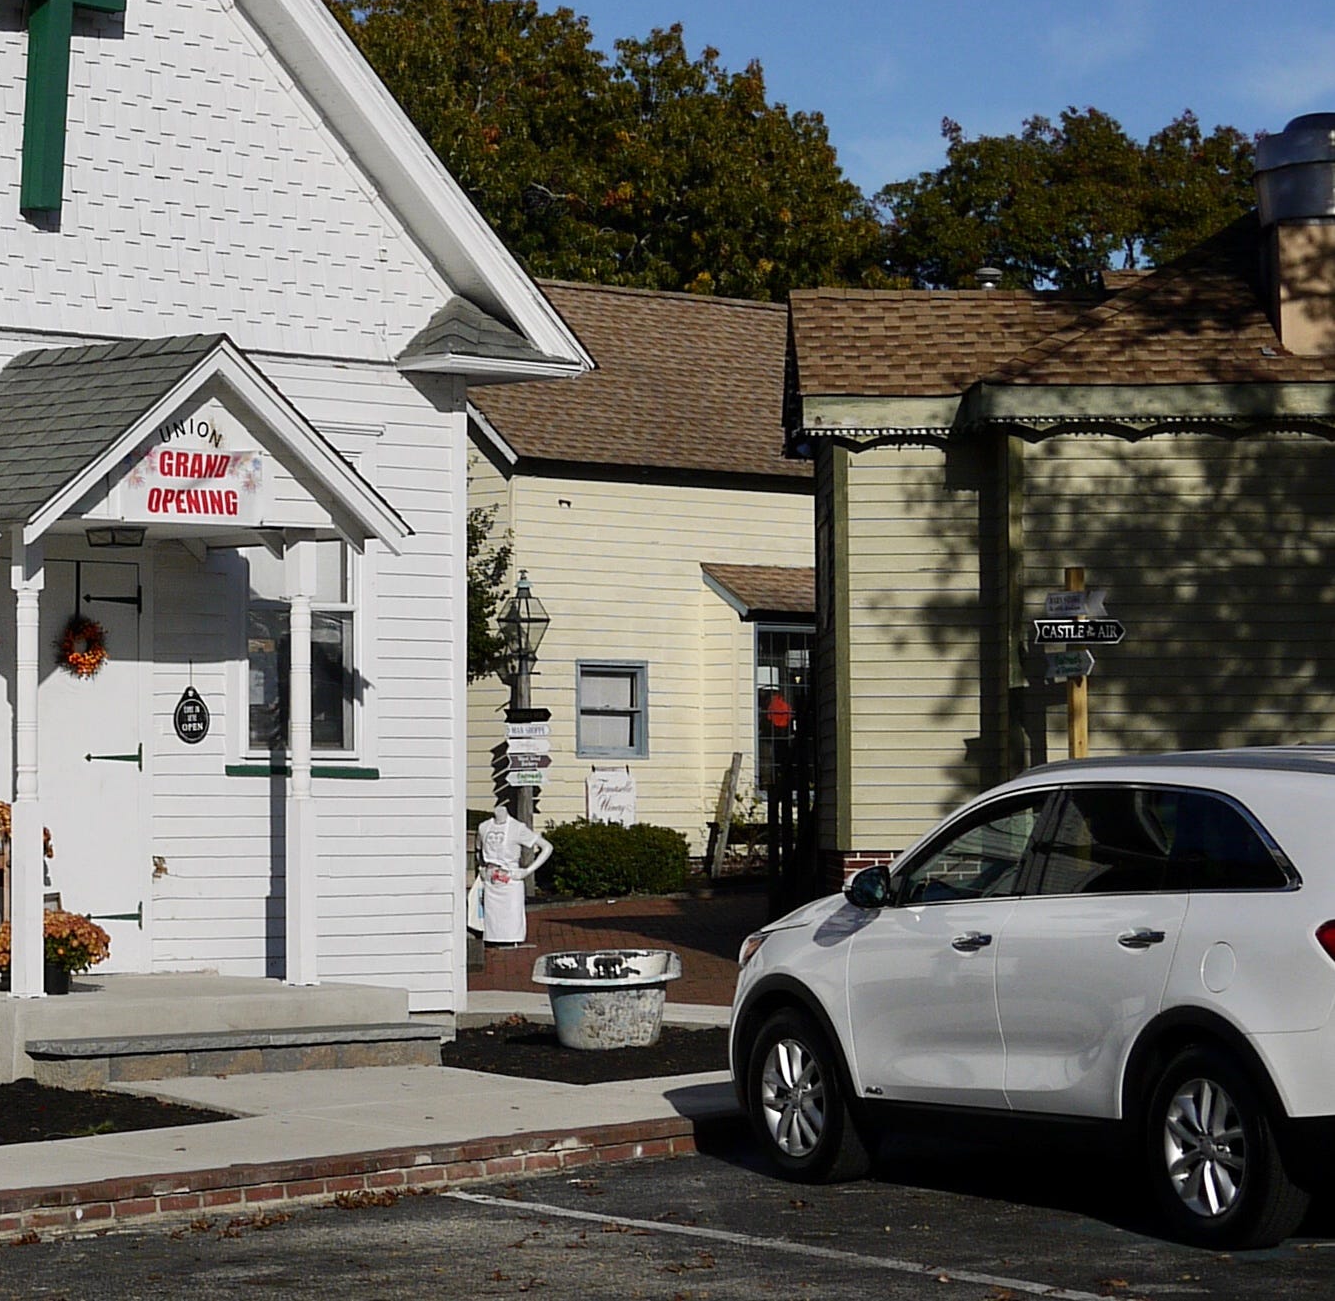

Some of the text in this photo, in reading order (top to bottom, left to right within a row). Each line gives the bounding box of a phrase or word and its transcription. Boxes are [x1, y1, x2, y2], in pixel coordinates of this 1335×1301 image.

[159, 418, 223, 448] UNION
[159, 450, 231, 479] GRAND
[147, 487, 239, 516] OPENING
[1041, 625, 1085, 639] CASTLE
[1097, 625, 1118, 639] AIR
[181, 722, 204, 731] OPEN
